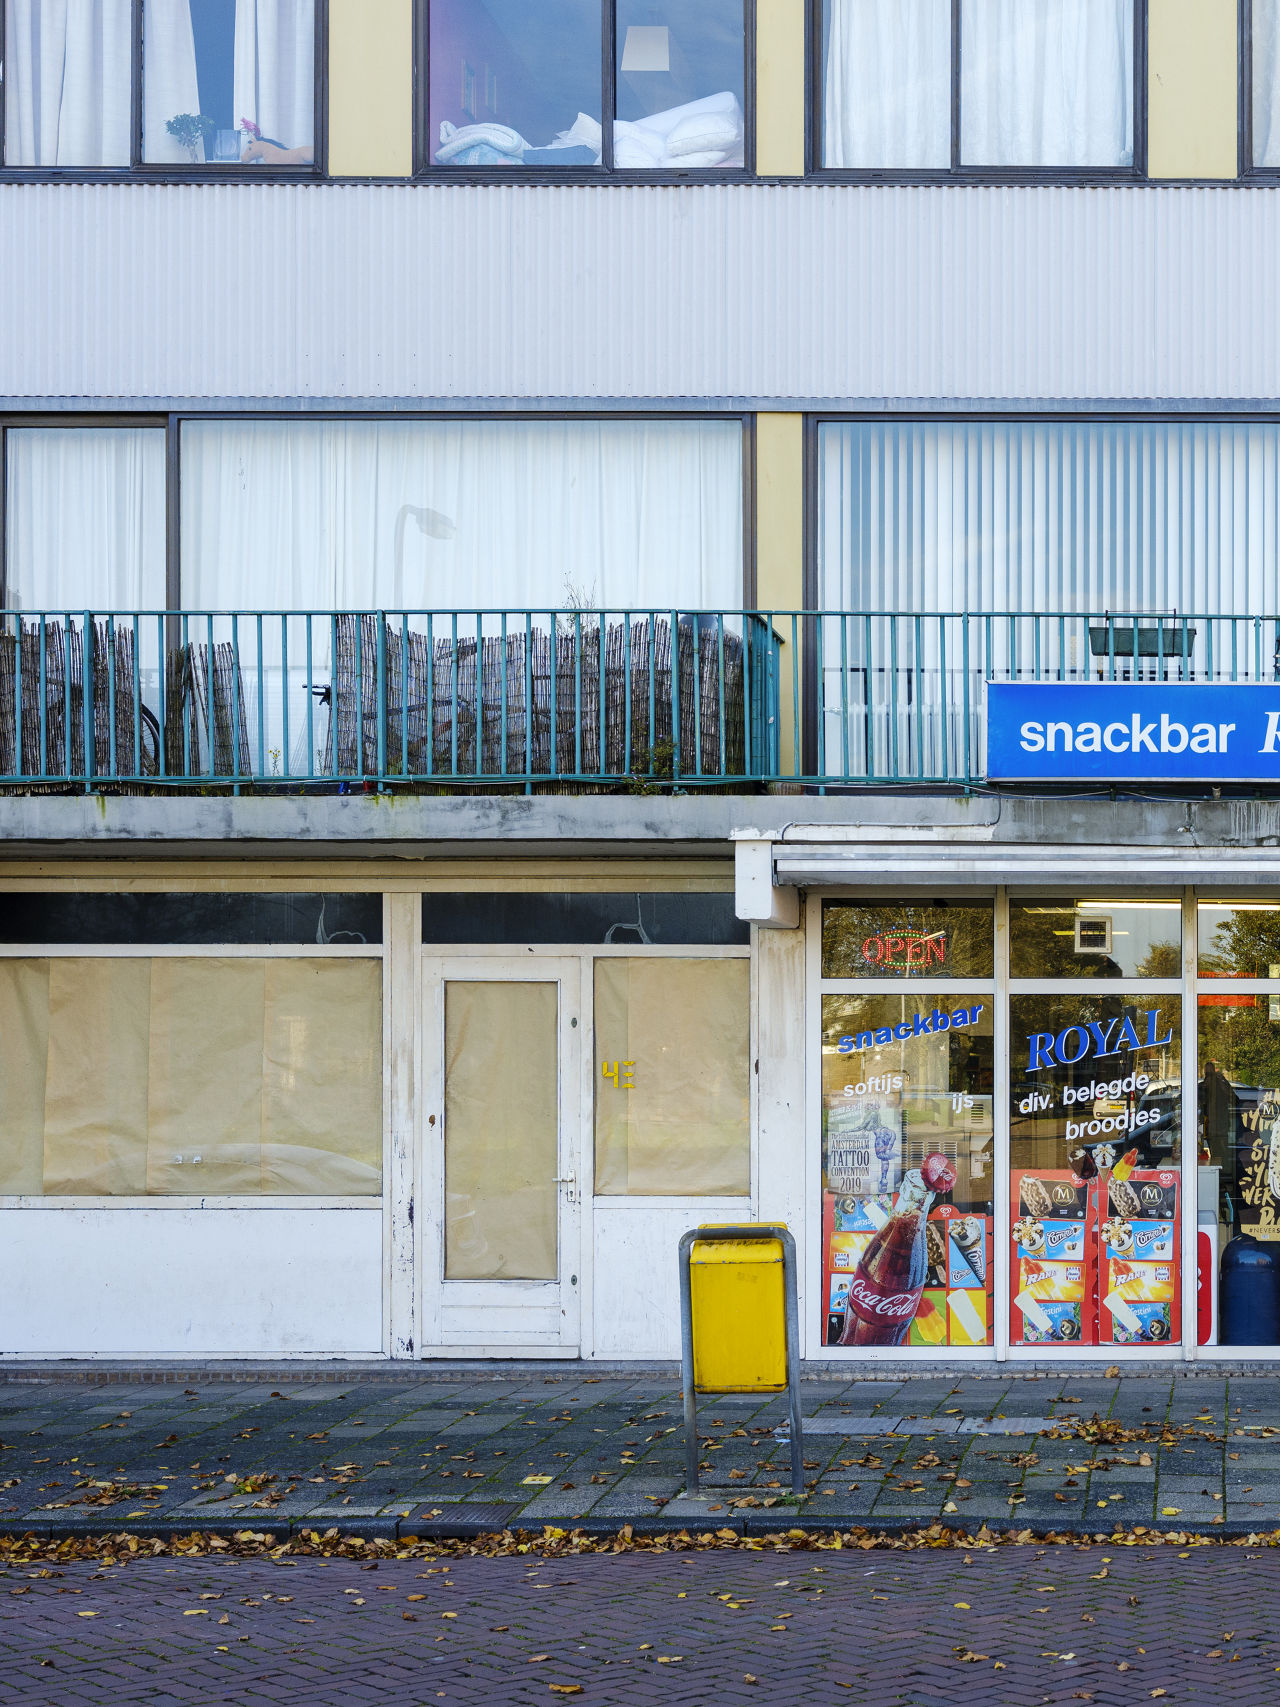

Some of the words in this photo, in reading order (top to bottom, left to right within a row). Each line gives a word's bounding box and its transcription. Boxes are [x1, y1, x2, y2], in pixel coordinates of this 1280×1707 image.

[1020, 714, 1235, 754] snackbar
[862, 937, 947, 963] OPEN
[838, 1004, 983, 1054] snackbar
[1025, 1009, 1173, 1072] ROYAL
[844, 1073, 903, 1098] softijs
[1019, 1092, 1054, 1114] div.
[1063, 1072, 1150, 1106] belegde
[952, 1093, 974, 1114] ijs
[1065, 1107, 1161, 1141] broodjes
[831, 1140, 870, 1150] AMSTERDAM
[831, 1151, 870, 1166] TATTOO
[831, 1167, 870, 1176] CONVENTION
[840, 1177, 861, 1192] 2019
